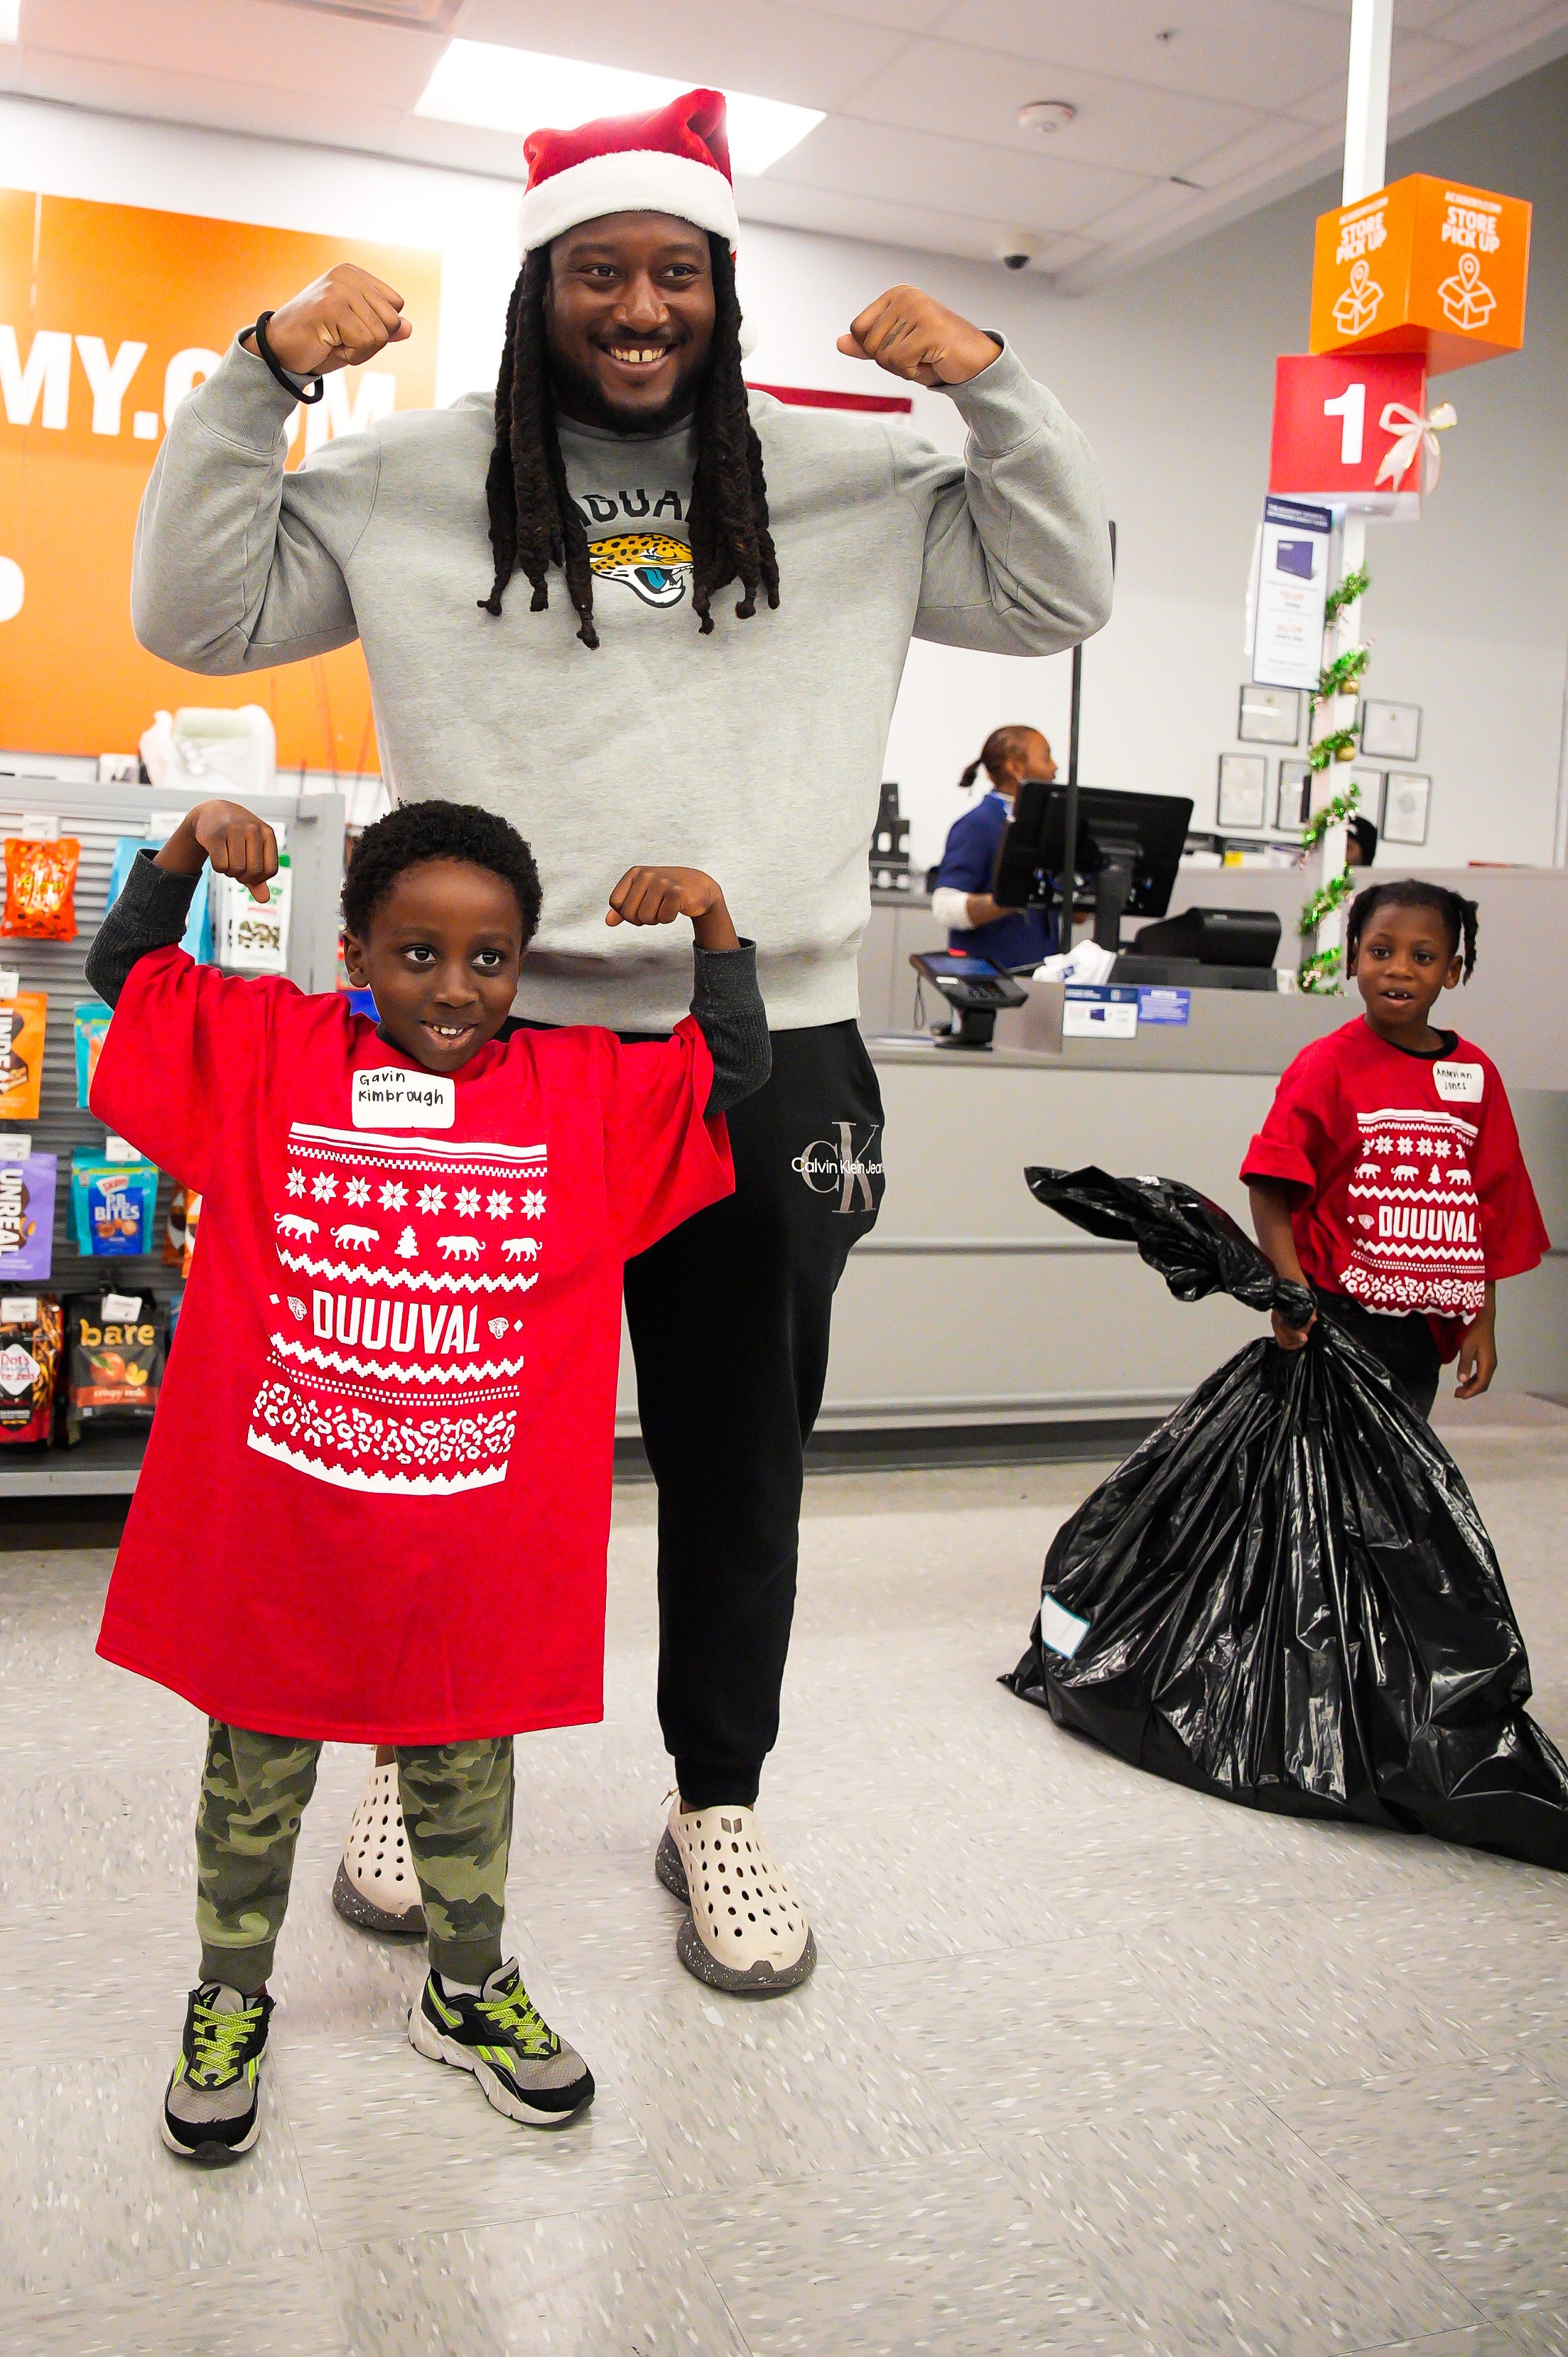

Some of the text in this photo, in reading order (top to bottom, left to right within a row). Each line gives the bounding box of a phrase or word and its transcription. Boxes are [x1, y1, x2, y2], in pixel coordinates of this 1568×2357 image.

[1341, 212, 1385, 244] STORE
[1447, 205, 1498, 235] STORE
[1336, 229, 1388, 265] PICK UP
[1442, 222, 1501, 254] PICK UP
[1324, 384, 1366, 464] 1
[359, 1071, 405, 1086] Gavin
[359, 1089, 443, 1106] Kimbrough
[791, 1157, 838, 1174] Calvin
[840, 1159, 865, 1175] Klein
[0, 1168, 23, 1258] UNREAL
[94, 1205, 141, 1222] BITES
[1378, 1205, 1477, 1243] DUUUVAL
[80, 1318, 155, 1347] bare
[313, 1289, 480, 1354] DUUUVAL
